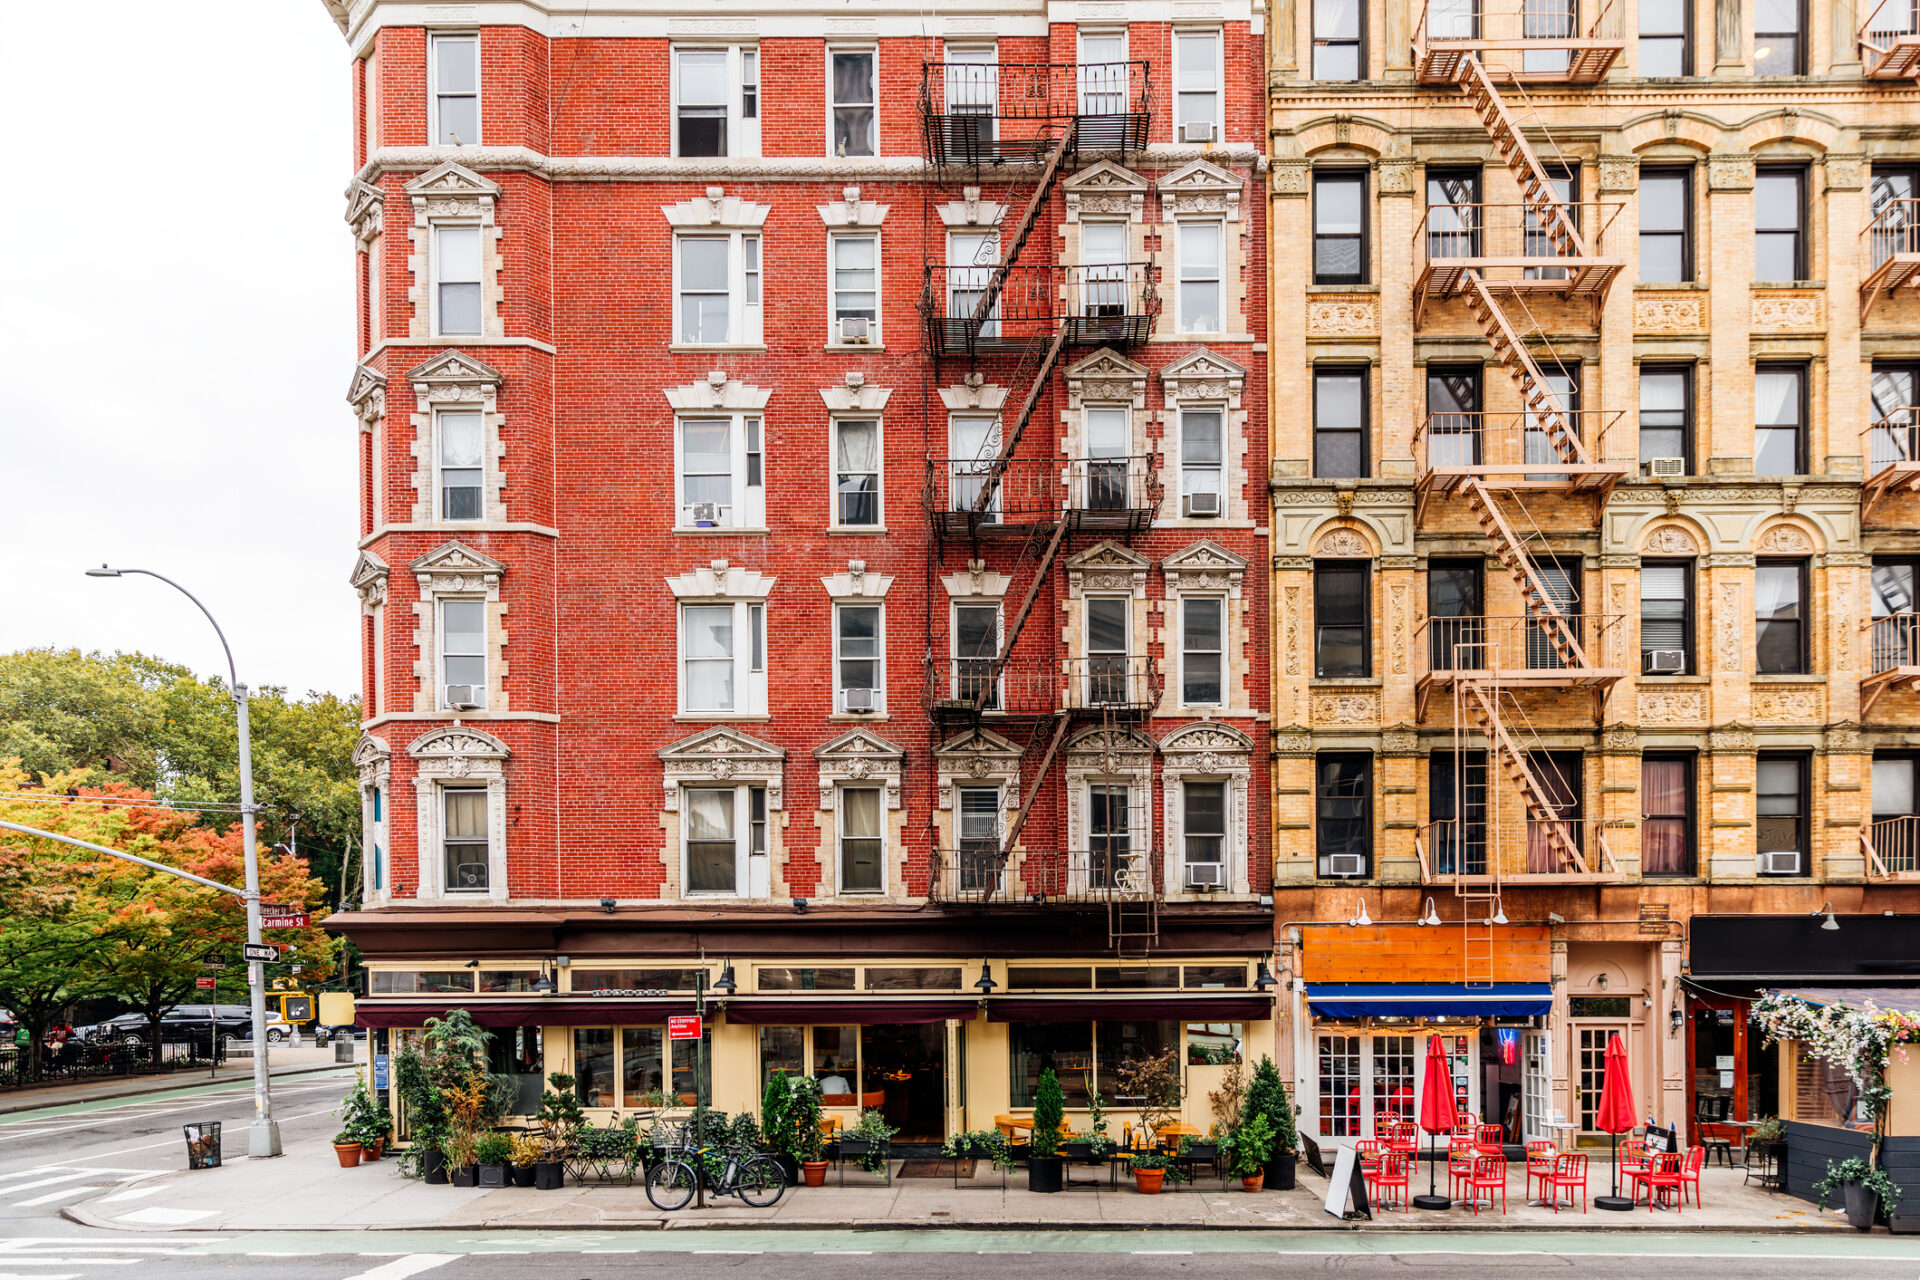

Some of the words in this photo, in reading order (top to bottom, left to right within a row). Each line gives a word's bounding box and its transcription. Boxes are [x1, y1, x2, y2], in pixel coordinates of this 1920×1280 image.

[263, 917, 294, 927] Carmine
[296, 917, 304, 926] St
[249, 948, 260, 956] ONE
